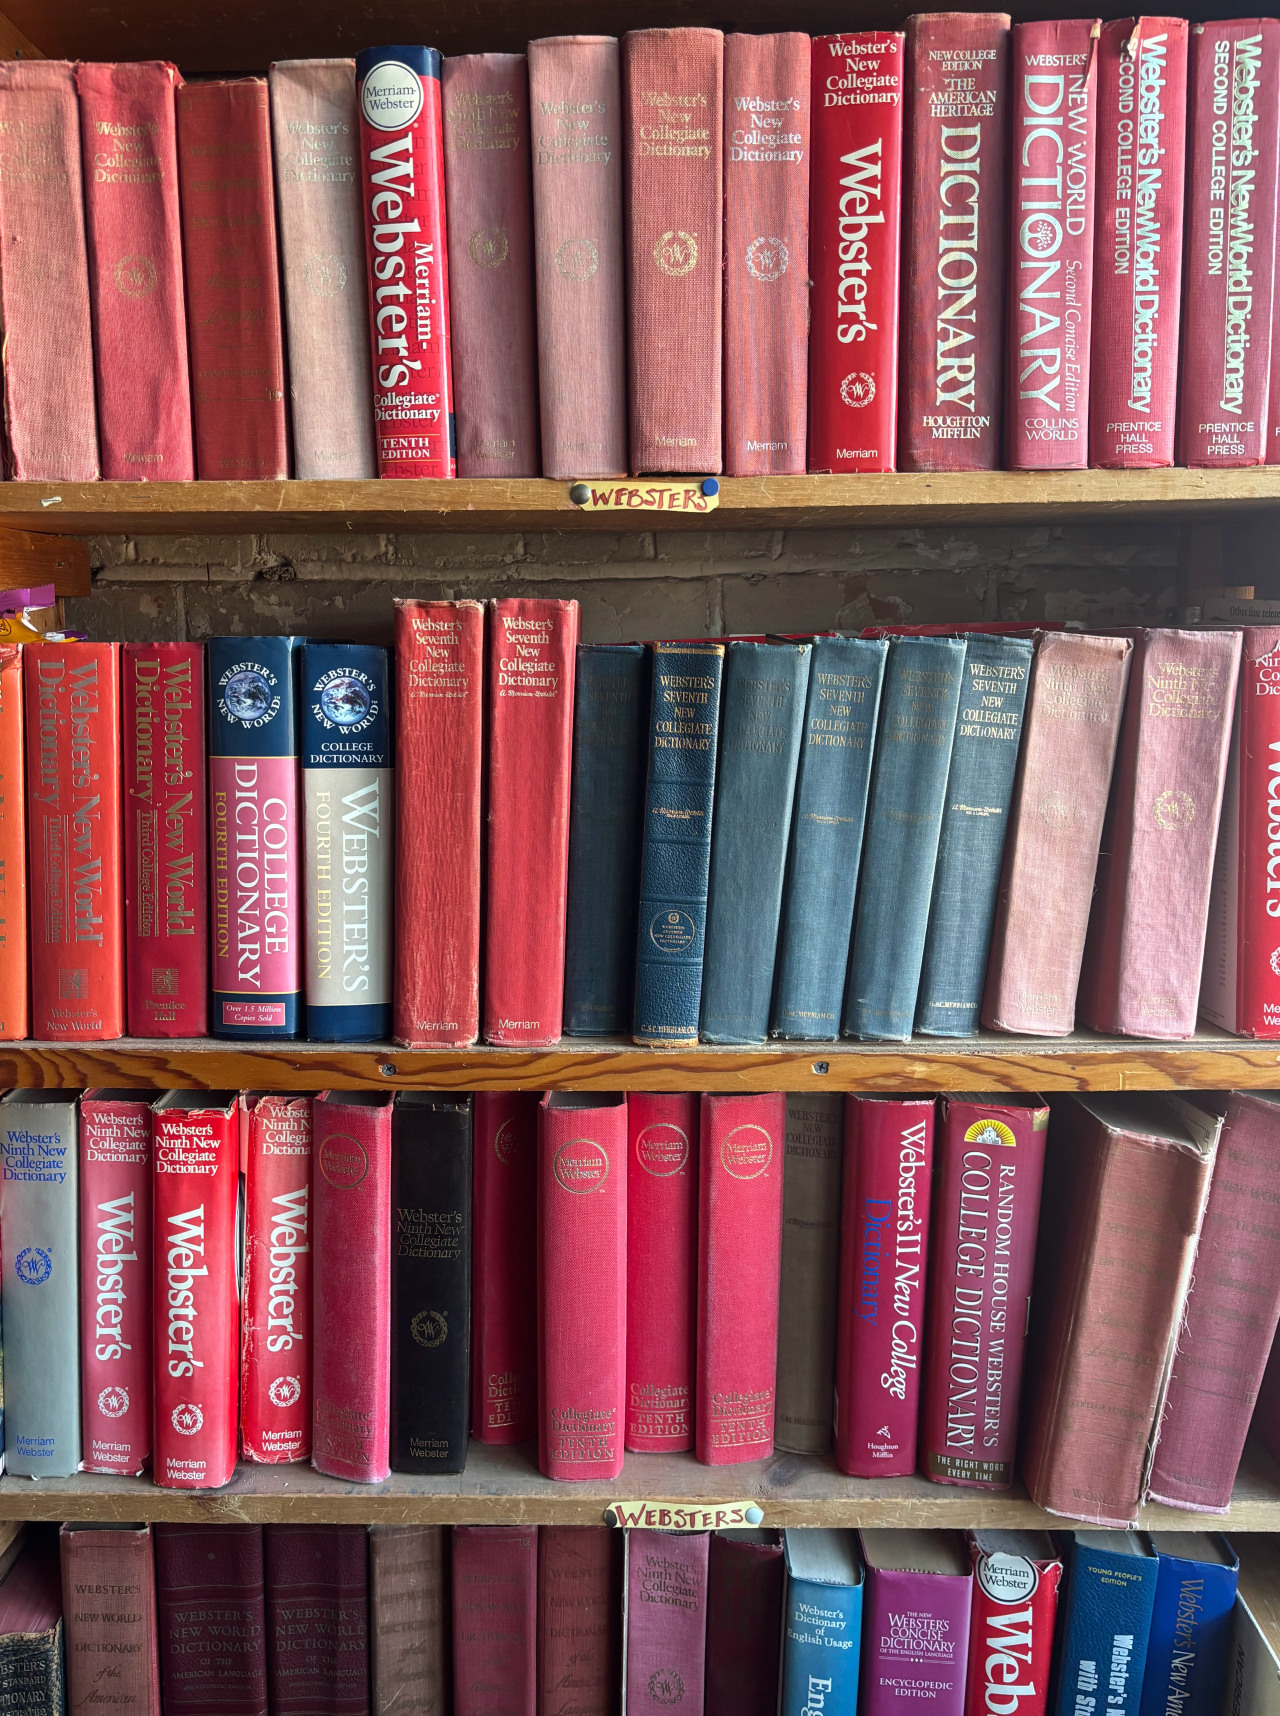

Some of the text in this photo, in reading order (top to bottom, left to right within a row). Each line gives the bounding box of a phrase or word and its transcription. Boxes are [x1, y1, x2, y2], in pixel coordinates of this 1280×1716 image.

[828, 40, 897, 56] Webster's
[929, 50, 996, 60] NEW COLLEGE
[846, 59, 880, 72] New
[942, 61, 982, 70] EDITION
[1025, 54, 1088, 66] WEBSTER'S
[826, 76, 898, 91] Collegiate
[950, 78, 975, 90] THE
[370, 99, 414, 111] Webster
[734, 97, 800, 112] Webster's
[824, 92, 900, 107] Dictionary
[928, 91, 996, 104] AMERICAN
[1138, 33, 1168, 166] Webster's
[1232, 34, 1262, 166] Webster's
[750, 114, 784, 128] New
[732, 130, 801, 148] Collegiate
[730, 147, 803, 164] Dictionary
[1066, 74, 1088, 235] NEW WORLD
[1117, 120, 1133, 200] COLLEGE
[1208, 41, 1229, 275] SECOND COLLEGE EDITION
[837, 138, 885, 343] Webster's
[1019, 75, 1064, 412] DICTIONARY
[1114, 207, 1131, 275] EDITION
[370, 132, 421, 388] Webster's
[936, 122, 981, 413] DICTIONARY
[1065, 260, 1082, 412] Second Concise Edition
[1127, 294, 1160, 414] Dictionary
[1220, 295, 1253, 415] Dictionary
[1025, 418, 1079, 428] COLLINS
[1107, 422, 1162, 432] PRENTICE
[1199, 422, 1254, 433] PRENTICE
[1026, 429, 1078, 440] WORLD
[1120, 434, 1148, 443] HALL
[1213, 434, 1240, 443] HALL
[382, 438, 429, 448] TENTH
[1116, 444, 1153, 454] PRESS
[1208, 445, 1245, 455] PRESS
[382, 449, 430, 458] EDITION
[836, 449, 877, 458] Merriam
[590, 489, 708, 510] WEBSTERS
[506, 631, 549, 644] Seventh
[516, 645, 540, 656] New
[500, 659, 555, 673] Collegiate
[970, 664, 1025, 680] WEBSTER'S
[219, 662, 278, 686] WEBSTER'S
[314, 668, 376, 692] WEBSTER'S
[499, 673, 558, 688] Dictionary
[973, 680, 1017, 694] SEVENTH
[981, 696, 1003, 708] NEW
[217, 698, 280, 729] NEW WORLD
[312, 704, 379, 734] NEW WORLD
[963, 711, 1018, 726] COLLEGIATE
[34, 659, 67, 810] Dictionary
[129, 658, 161, 805] Dictionary
[959, 725, 1016, 740] DICTIONARY
[321, 743, 373, 751] COLLEGE
[310, 755, 384, 763] DICTIONARY
[69, 659, 103, 943] Webster's New World
[164, 658, 195, 938] Webster's New World
[235, 762, 261, 989] DICTIONARY
[263, 798, 289, 954] COLLEGE
[316, 792, 332, 980] FOURTH EDITION
[342, 777, 380, 992] WEBSTER'S
[92, 1113, 143, 1125] Webster's
[86, 1126, 150, 1138] Ninth New
[162, 1123, 213, 1135] Webster's
[90, 1138, 146, 1152] Collegiate
[155, 1136, 221, 1148] Ninth New
[87, 1150, 148, 1165] Dictionary
[159, 1149, 216, 1163] Collegiate
[156, 1161, 218, 1176] Dictionary
[398, 1208, 462, 1223] Webster's
[397, 1222, 464, 1235] Ninth New
[400, 1234, 459, 1248] Collegiate
[398, 1246, 461, 1260] Dictionary
[881, 1119, 926, 1400] Webster's II New College
[266, 1184, 310, 1352] Webster's
[852, 1198, 891, 1327] Dictionary
[95, 1191, 138, 1361] Webster's
[167, 1204, 209, 1378] Webster's
[946, 1151, 991, 1455] COLLEGE DICTIONARY
[983, 1164, 1015, 1447] RANDOM HOUSE WEBSTER'S
[262, 1430, 302, 1439] Merriam
[262, 1441, 301, 1451] Webster
[867, 1443, 898, 1451] Houghton
[552, 1449, 614, 1459] EDITION
[167, 1458, 206, 1468] Merriam
[937, 1455, 1004, 1471] THE RIGHT WORD
[167, 1469, 206, 1479] Webster
[948, 1468, 993, 1481] EVERY TIME
[615, 1504, 743, 1528] WEBSTERS
[983, 1562, 1029, 1578] Merriam
[1088, 1566, 1142, 1581] YOUNG PEOPLE'S
[985, 1576, 1028, 1589] Webster
[1101, 1577, 1127, 1586] EDITION
[176, 1611, 254, 1623] WEBSTER'S
[800, 1603, 843, 1618] Webster's
[1174, 1579, 1205, 1649] Webster's
[795, 1612, 846, 1629] Dictionary
[888, 1613, 949, 1631] WEBSTER'S
[169, 1626, 261, 1639] NEW WORLD
[787, 1628, 853, 1649] English Usage
[815, 1627, 825, 1636] of
[891, 1627, 943, 1641] CONCISE
[170, 1641, 262, 1654] DICTIONARY
[881, 1637, 955, 1652] DICTIONARY
[1107, 1635, 1134, 1711] Webster's
[1170, 1650, 1195, 1686] New
[880, 1678, 953, 1690] ENCYCLOPEDIC
[1078, 1660, 1097, 1700] with
[895, 1688, 936, 1698] EDITION
